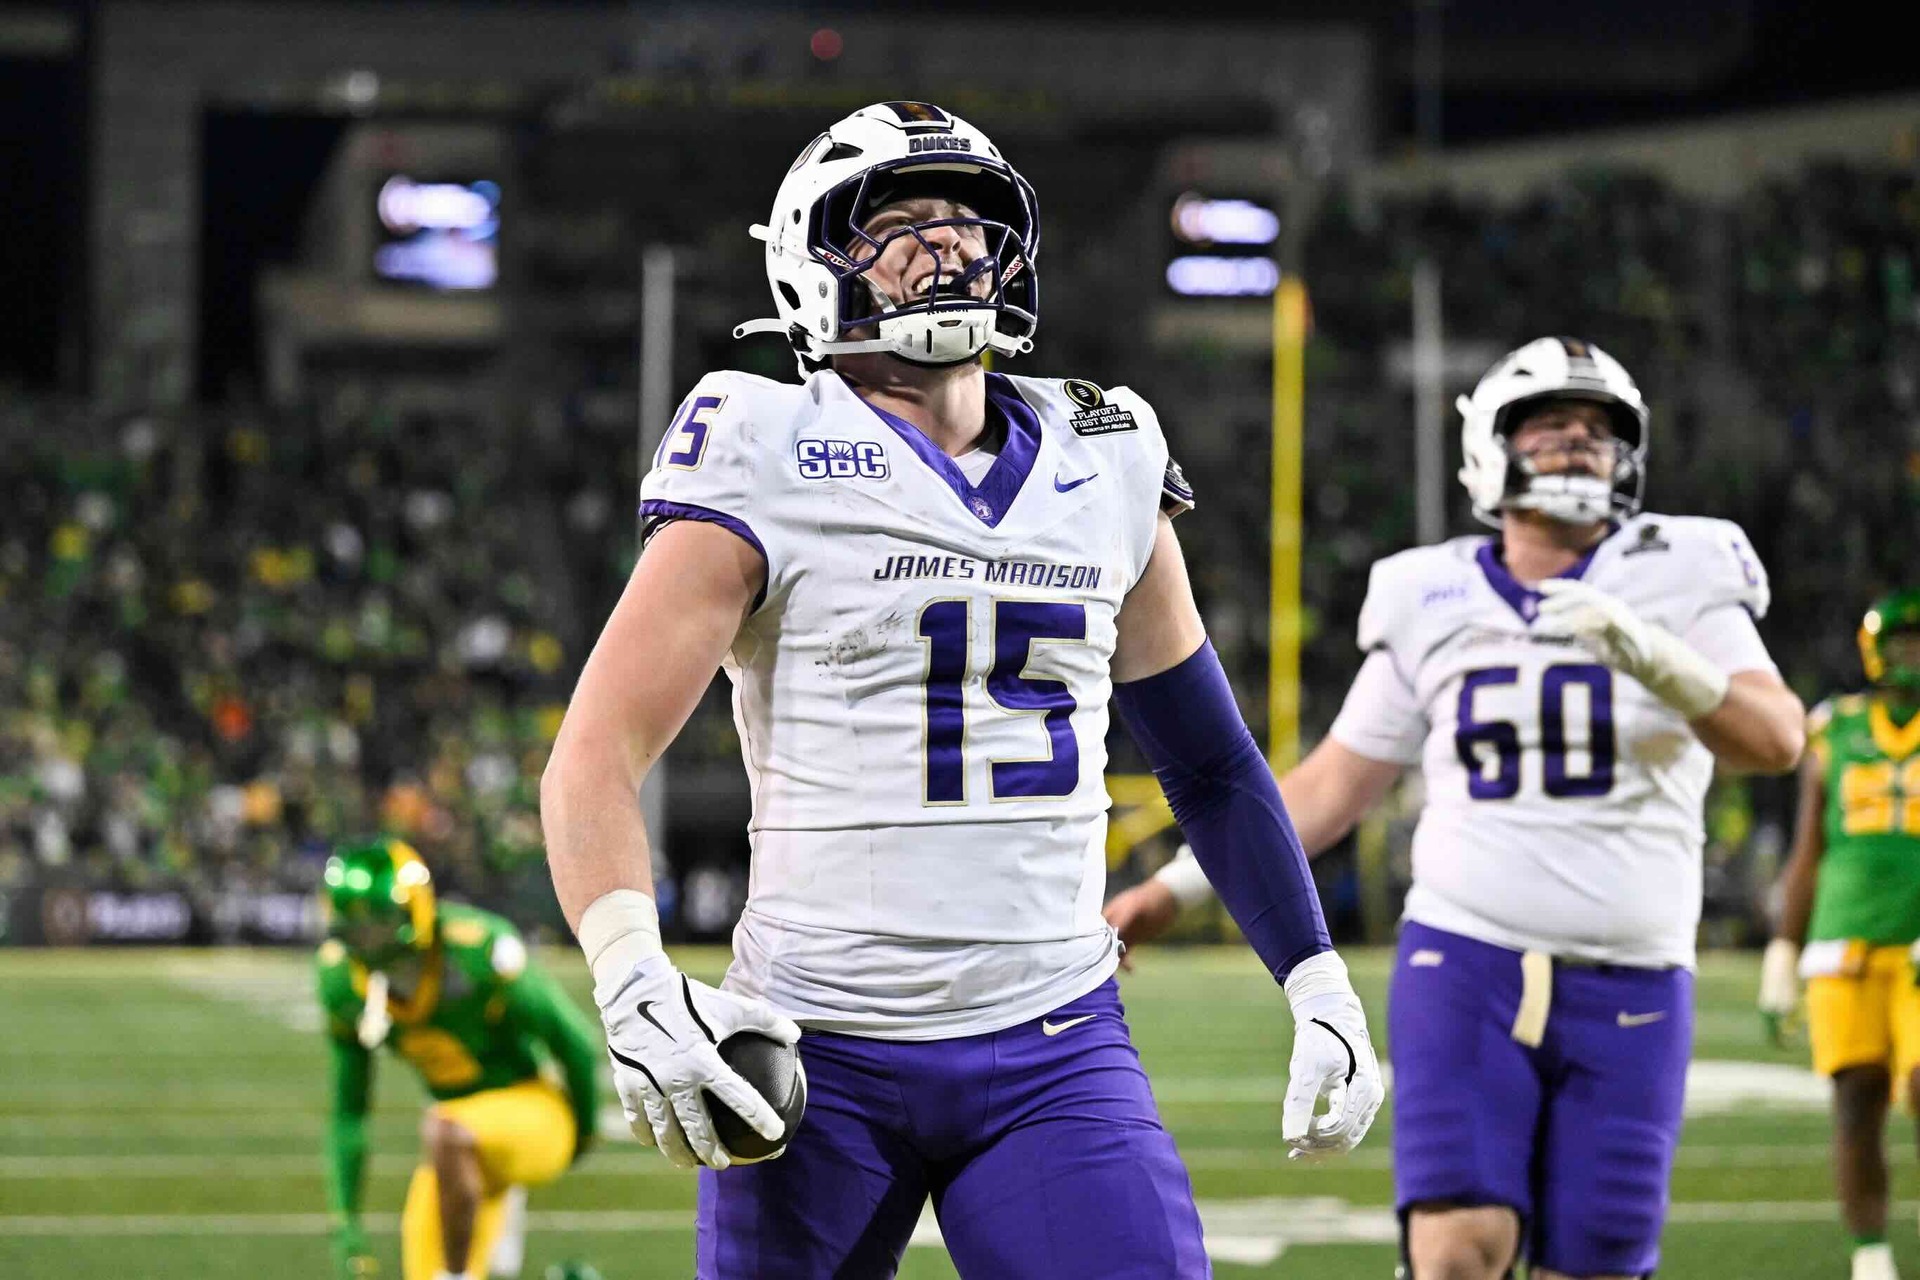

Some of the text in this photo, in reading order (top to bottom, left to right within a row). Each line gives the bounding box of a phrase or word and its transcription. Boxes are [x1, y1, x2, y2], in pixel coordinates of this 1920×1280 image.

[908, 136, 972, 153] DUKES
[1071, 417, 1099, 428] FIRST
[1099, 412, 1132, 424] ROUND
[1076, 406, 1117, 420] PLAYOFF
[796, 439, 888, 479] SBC
[873, 555, 1102, 590] JAMES MADISON
[915, 596, 1088, 807] 15
[1455, 661, 1617, 800] 60
